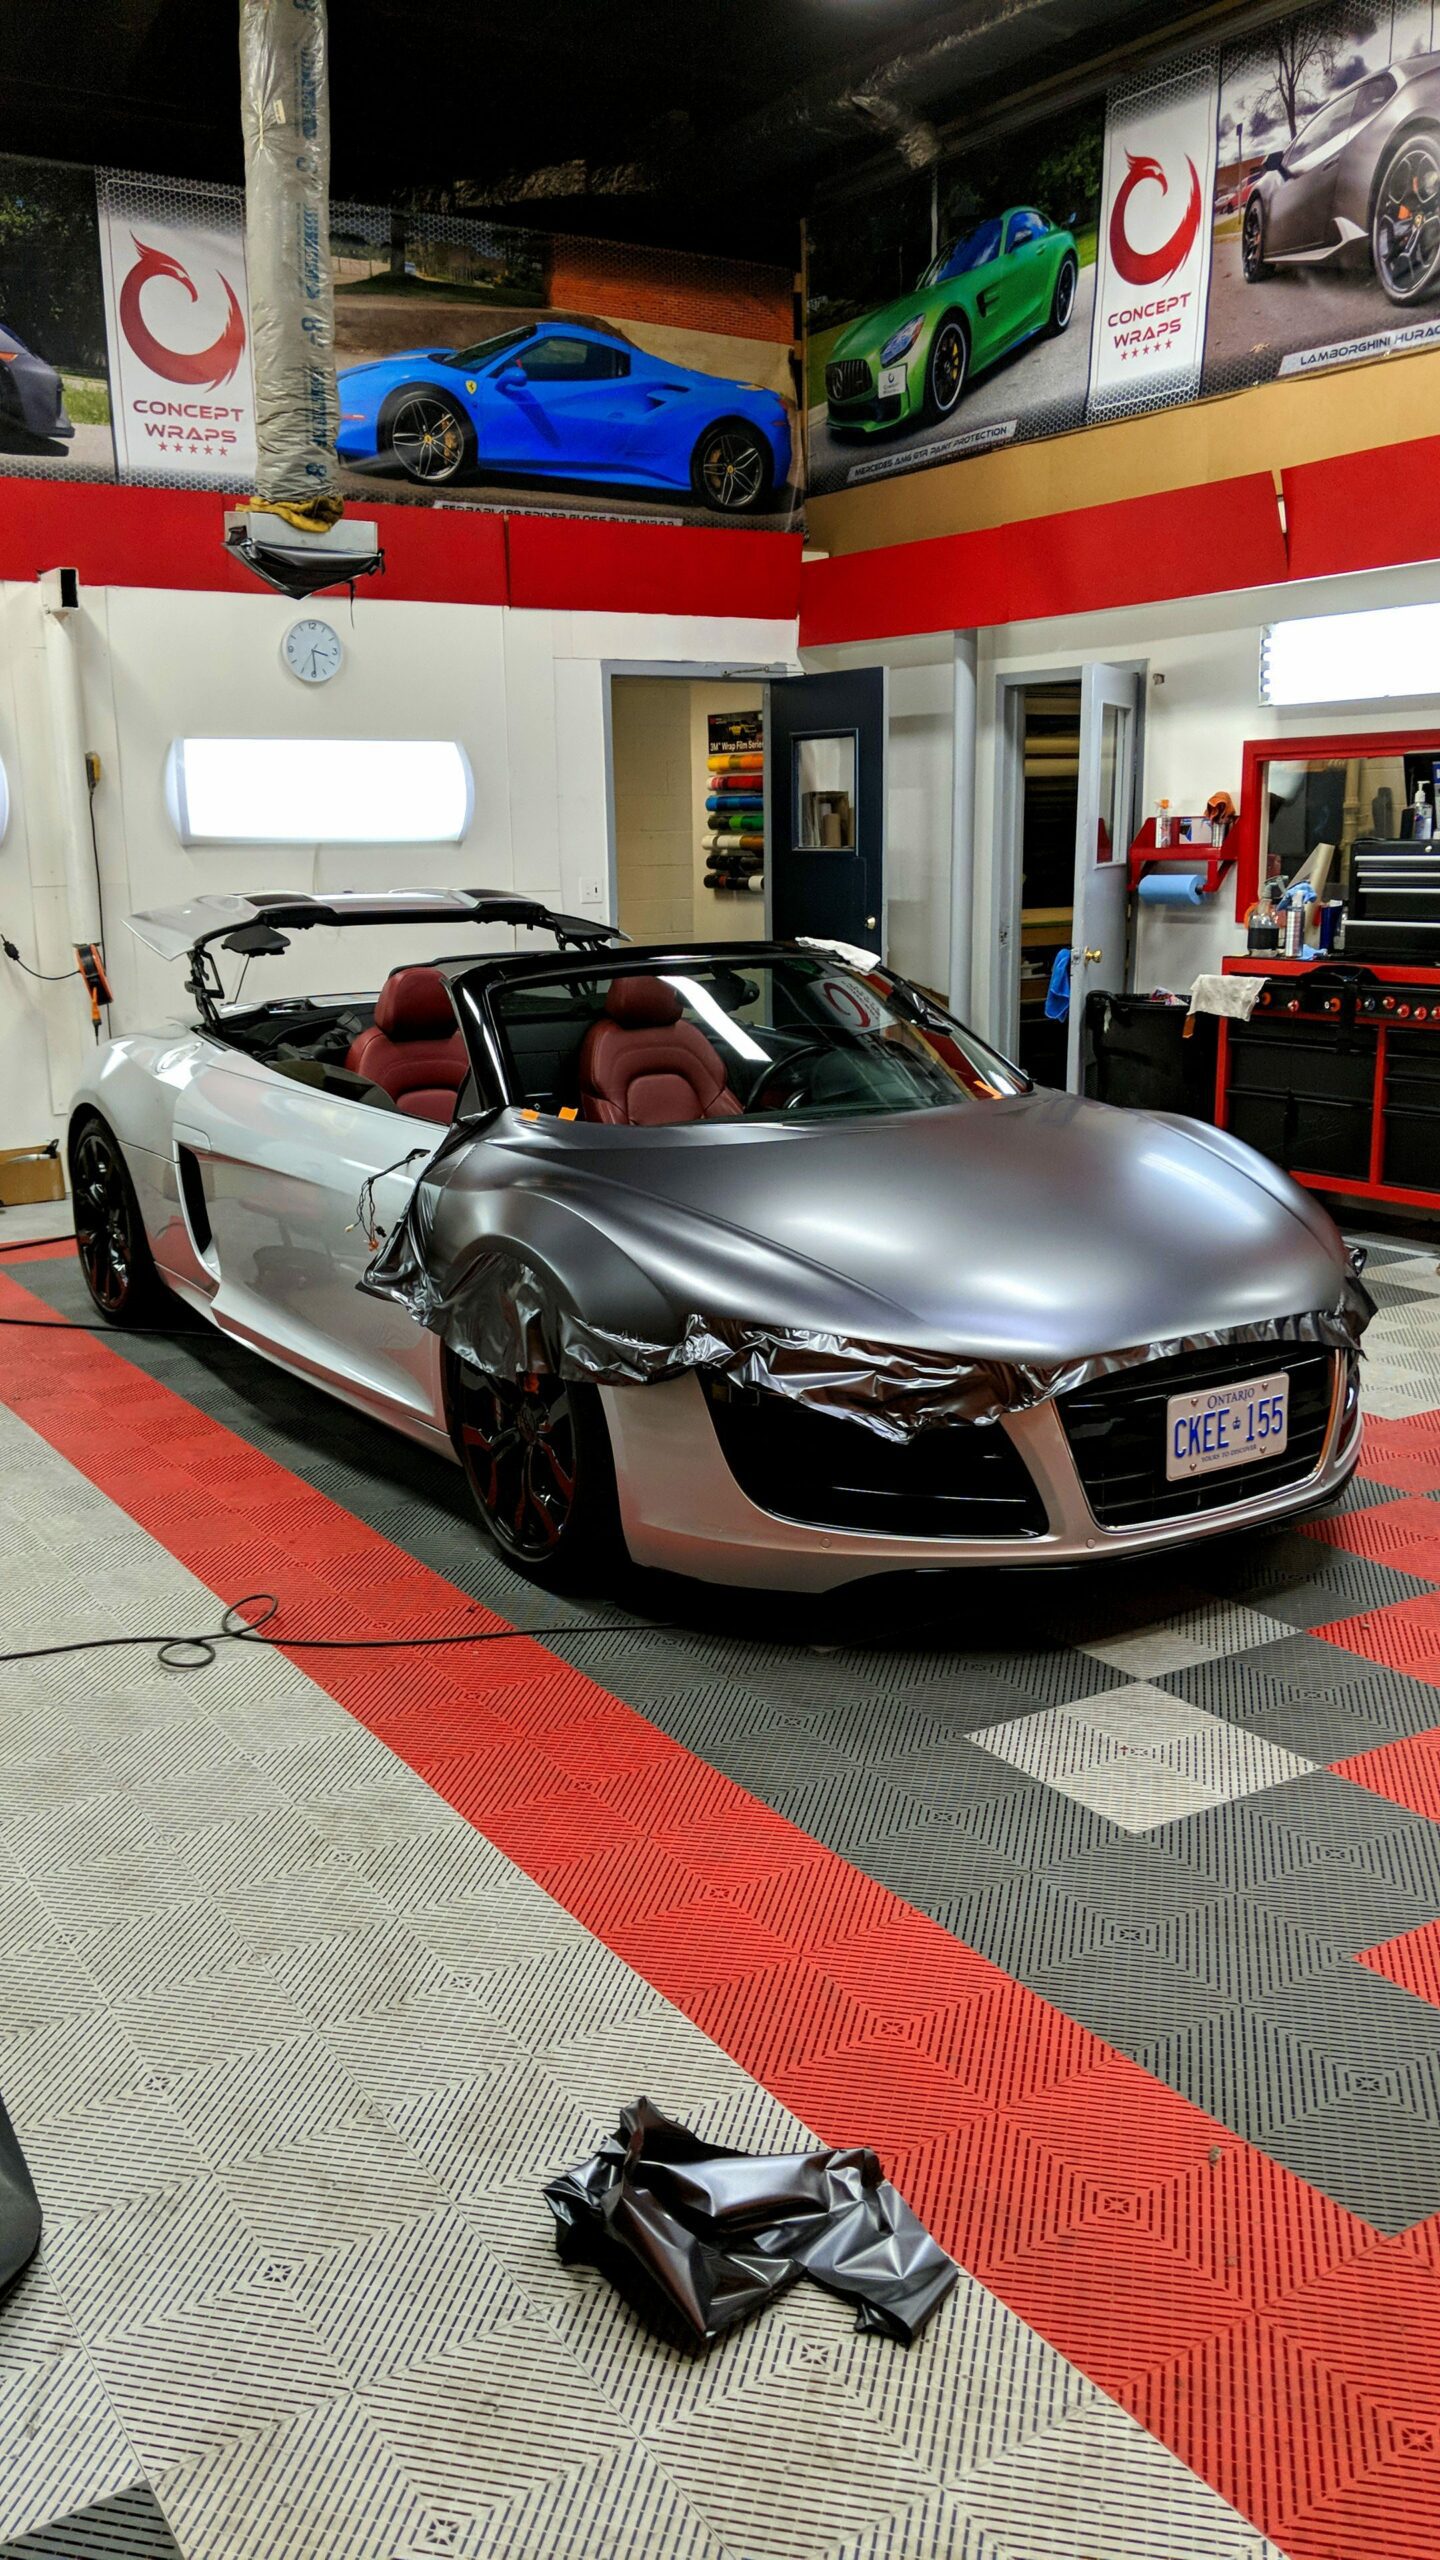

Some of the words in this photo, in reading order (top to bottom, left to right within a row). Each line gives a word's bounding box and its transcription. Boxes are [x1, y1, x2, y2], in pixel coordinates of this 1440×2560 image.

[1107, 291, 1192, 328] CONCEPT
[1113, 317, 1182, 349] WRAPS
[1300, 336, 1391, 366] LAMBORGHINI
[133, 399, 244, 422] CONCEPT
[144, 423, 237, 444] WRAPS
[854, 460, 892, 476] MERCEDES
[894, 455, 912, 466] AMG
[953, 426, 1008, 447] PROTECTION
[748, 740, 763, 749] Serie
[1207, 1388, 1255, 1409] ONTARIO
[1174, 1407, 1231, 1459] CKEE
[1246, 1393, 1284, 1442] 155
